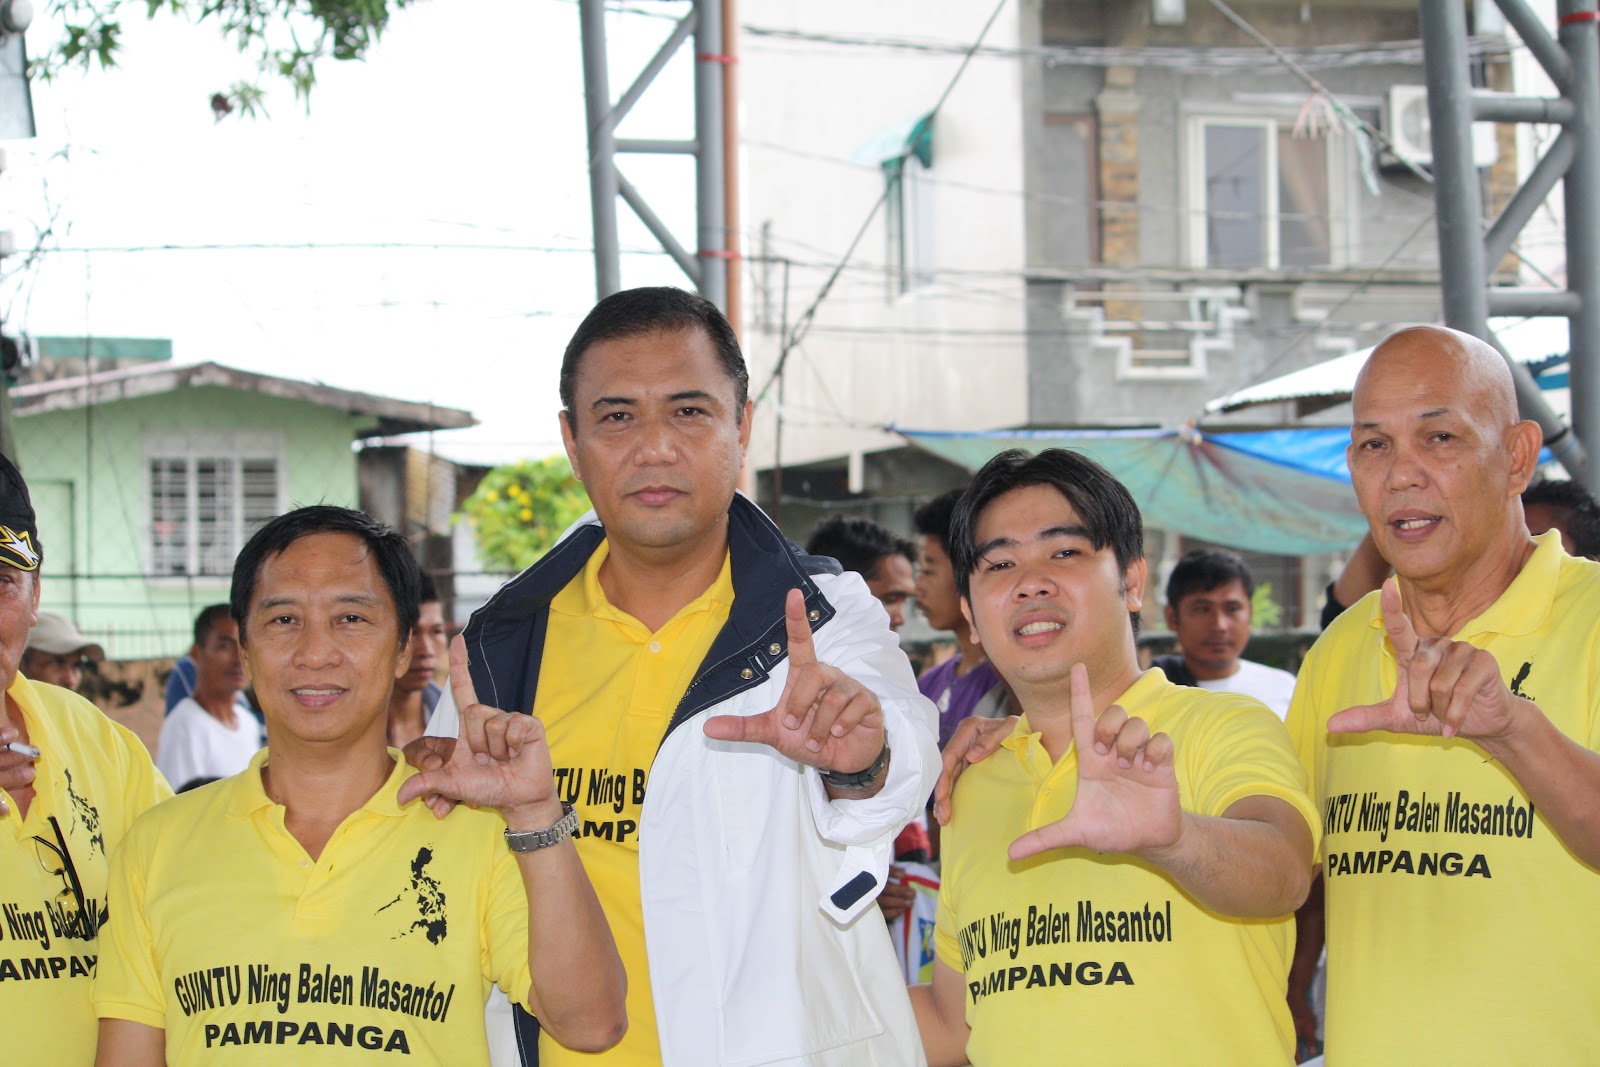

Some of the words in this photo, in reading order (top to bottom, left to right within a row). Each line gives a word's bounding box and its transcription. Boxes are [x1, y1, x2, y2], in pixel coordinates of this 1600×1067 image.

[586, 768, 626, 814] Ning
[1357, 792, 1391, 842] Ning
[1394, 790, 1440, 833] Balen
[1444, 791, 1535, 839] Masantol
[1328, 850, 1492, 878] PAMPANGA
[2, 903, 51, 951] Ning
[990, 911, 1021, 960] Ning
[1026, 903, 1070, 947] Balen
[1076, 900, 1172, 943] Masantol
[174, 964, 241, 1017] GUINTU
[248, 963, 291, 1014] Ning
[297, 963, 353, 1006] Balen
[360, 965, 456, 1023] Masantol
[968, 961, 1135, 1006] PAMPANGA
[204, 1020, 411, 1055] PAMPANGA
